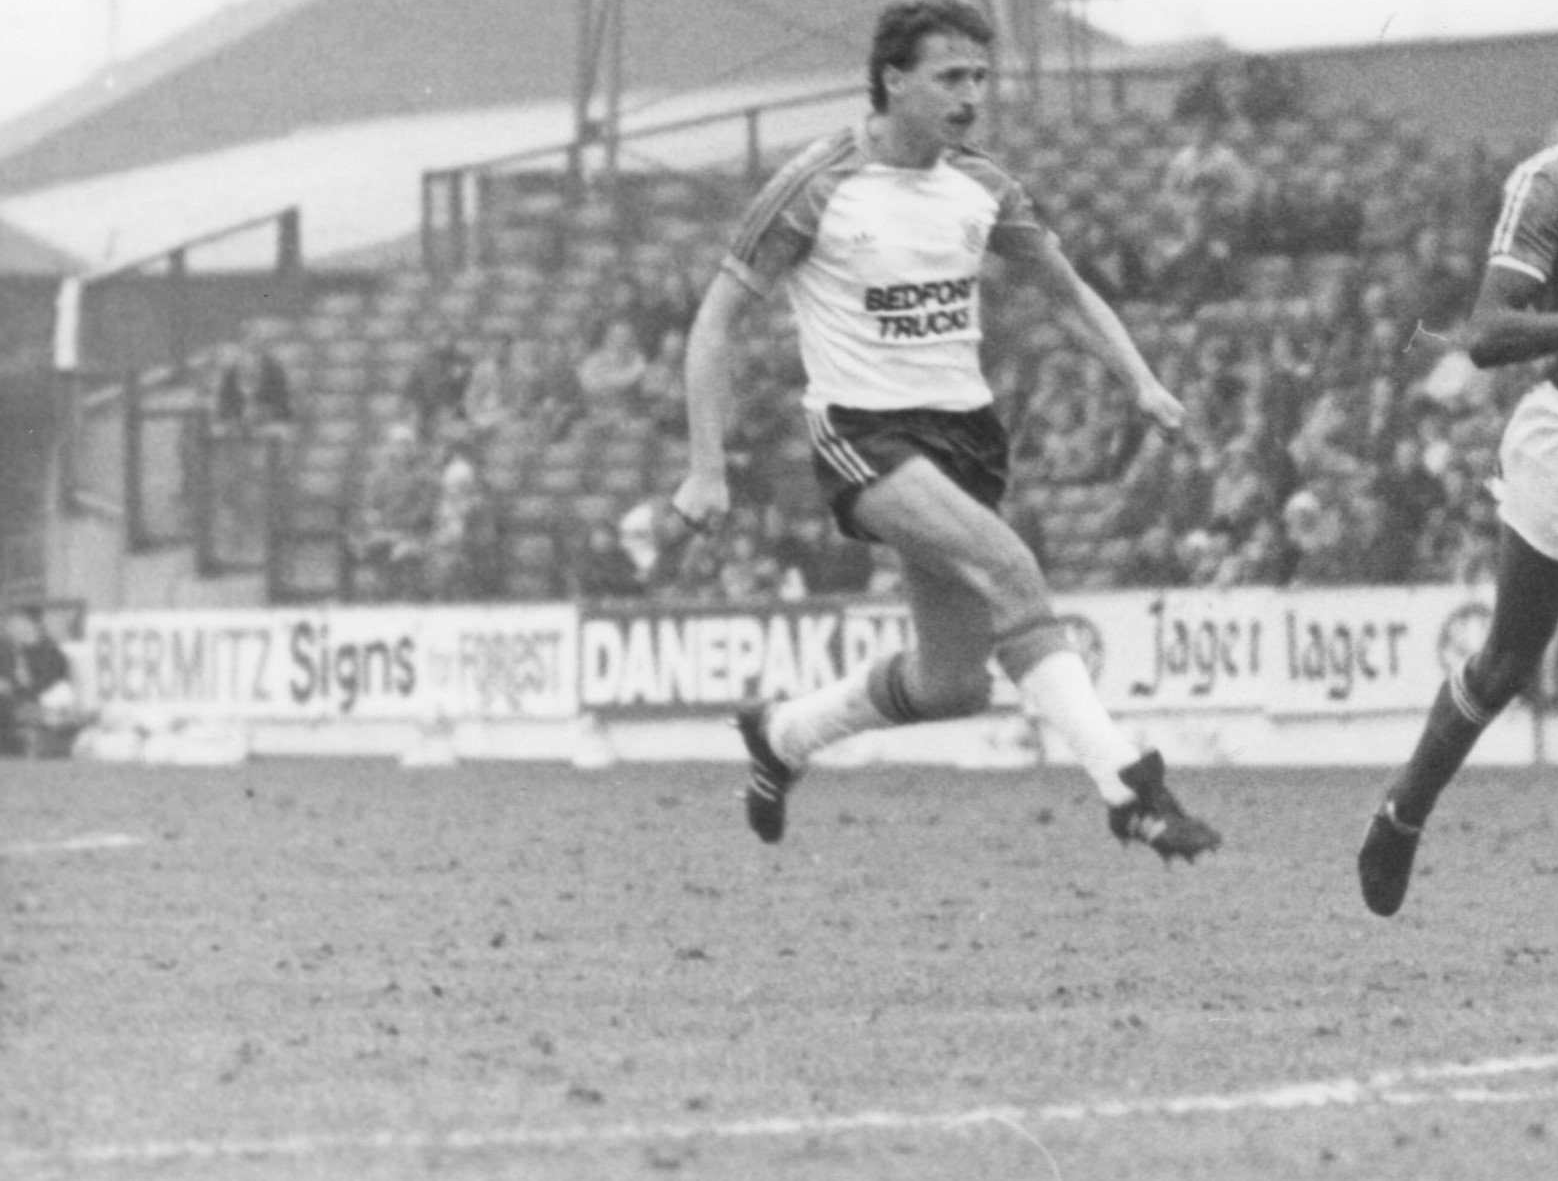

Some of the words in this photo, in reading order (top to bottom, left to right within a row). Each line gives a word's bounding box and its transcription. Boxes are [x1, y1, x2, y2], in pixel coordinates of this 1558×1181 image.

[865, 276, 977, 312] BEDFOR
[94, 627, 272, 703] BERMITZ
[288, 620, 416, 712] Signs
[580, 618, 841, 703] DANEPAK
[1285, 609, 1408, 700] lager
